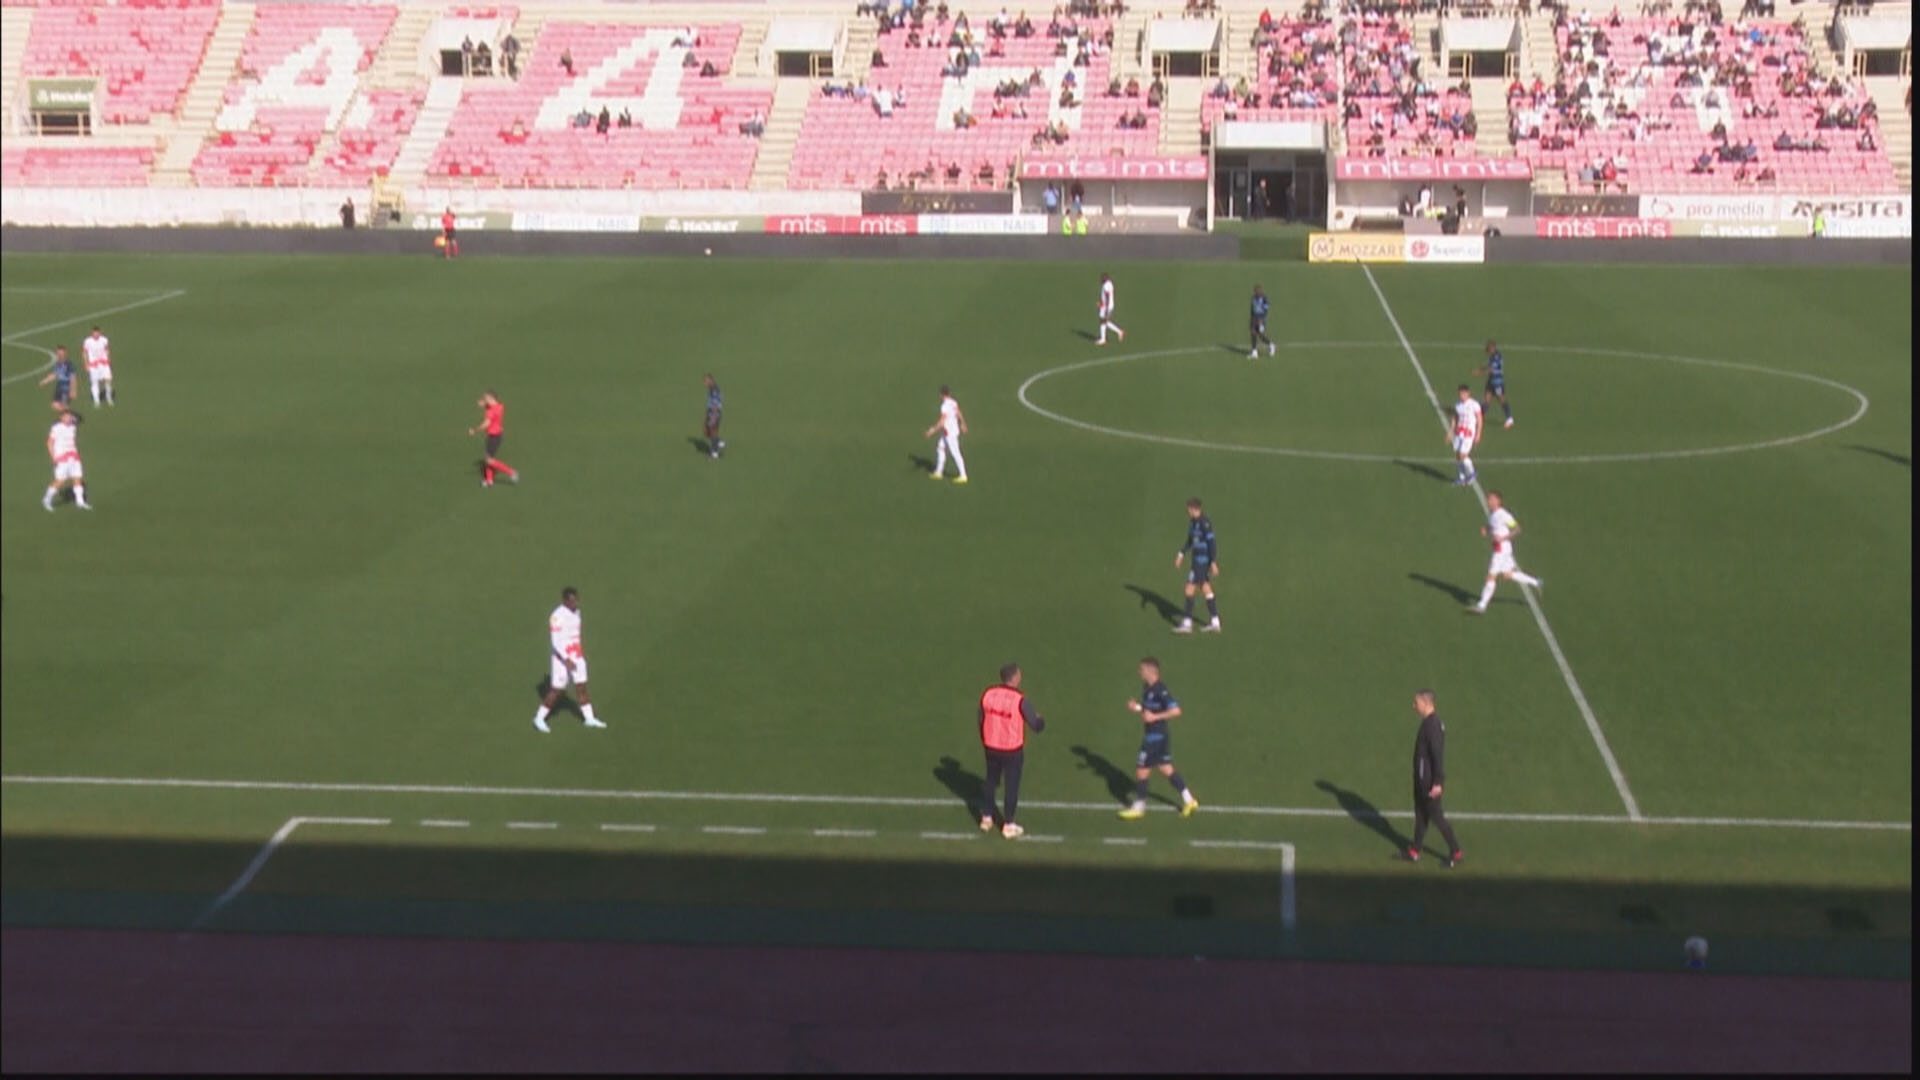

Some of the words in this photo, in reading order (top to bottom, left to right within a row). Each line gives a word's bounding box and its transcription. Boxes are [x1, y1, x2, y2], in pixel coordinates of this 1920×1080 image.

[1023, 158, 1107, 177] mts
[1122, 158, 1207, 177] mts
[1344, 158, 1432, 177] mts
[1442, 158, 1530, 177] mts
[1686, 204, 1713, 218] pro
[1717, 201, 1764, 216] media
[780, 215, 827, 234] mts
[860, 215, 907, 234] mts
[1547, 217, 1597, 237] mts
[1617, 217, 1667, 237] mts
[1338, 244, 1404, 257] MOZZART
